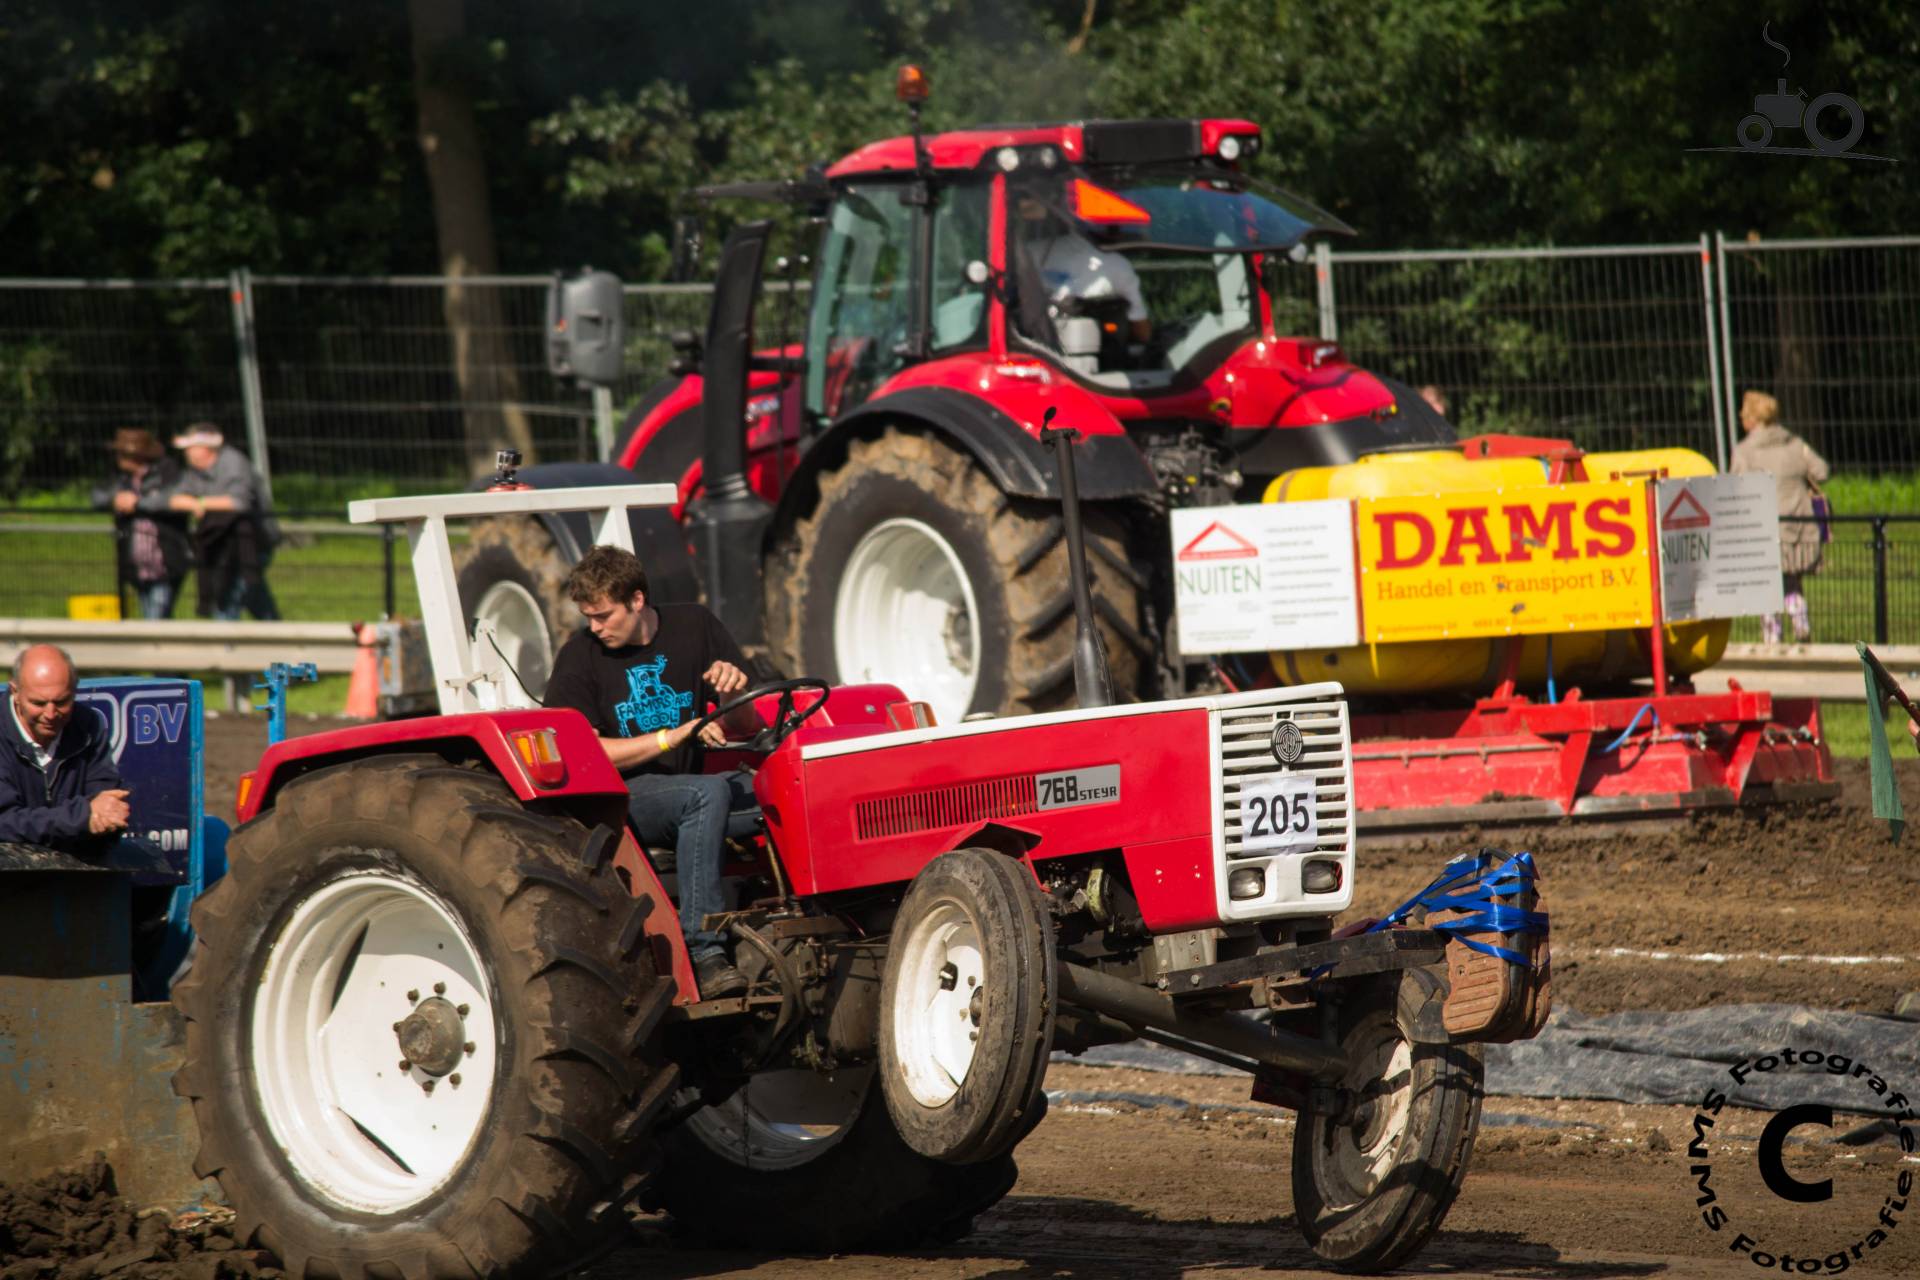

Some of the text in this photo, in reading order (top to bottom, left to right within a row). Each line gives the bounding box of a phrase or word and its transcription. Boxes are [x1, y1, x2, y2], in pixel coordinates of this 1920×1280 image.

[1373, 497, 1637, 571] DAMS
[1664, 532, 1711, 564] NUITEN
[1178, 564, 1262, 595] NUITEN
[1377, 577, 1453, 601] Handel
[1460, 579, 1486, 594] en
[1492, 571, 1595, 595] Transport
[1601, 567, 1638, 588] B.V.
[133, 702, 188, 745] BV
[640, 711, 679, 729] COOL
[1039, 775, 1118, 806] 768 STEYR
[1249, 792, 1310, 837] 205
